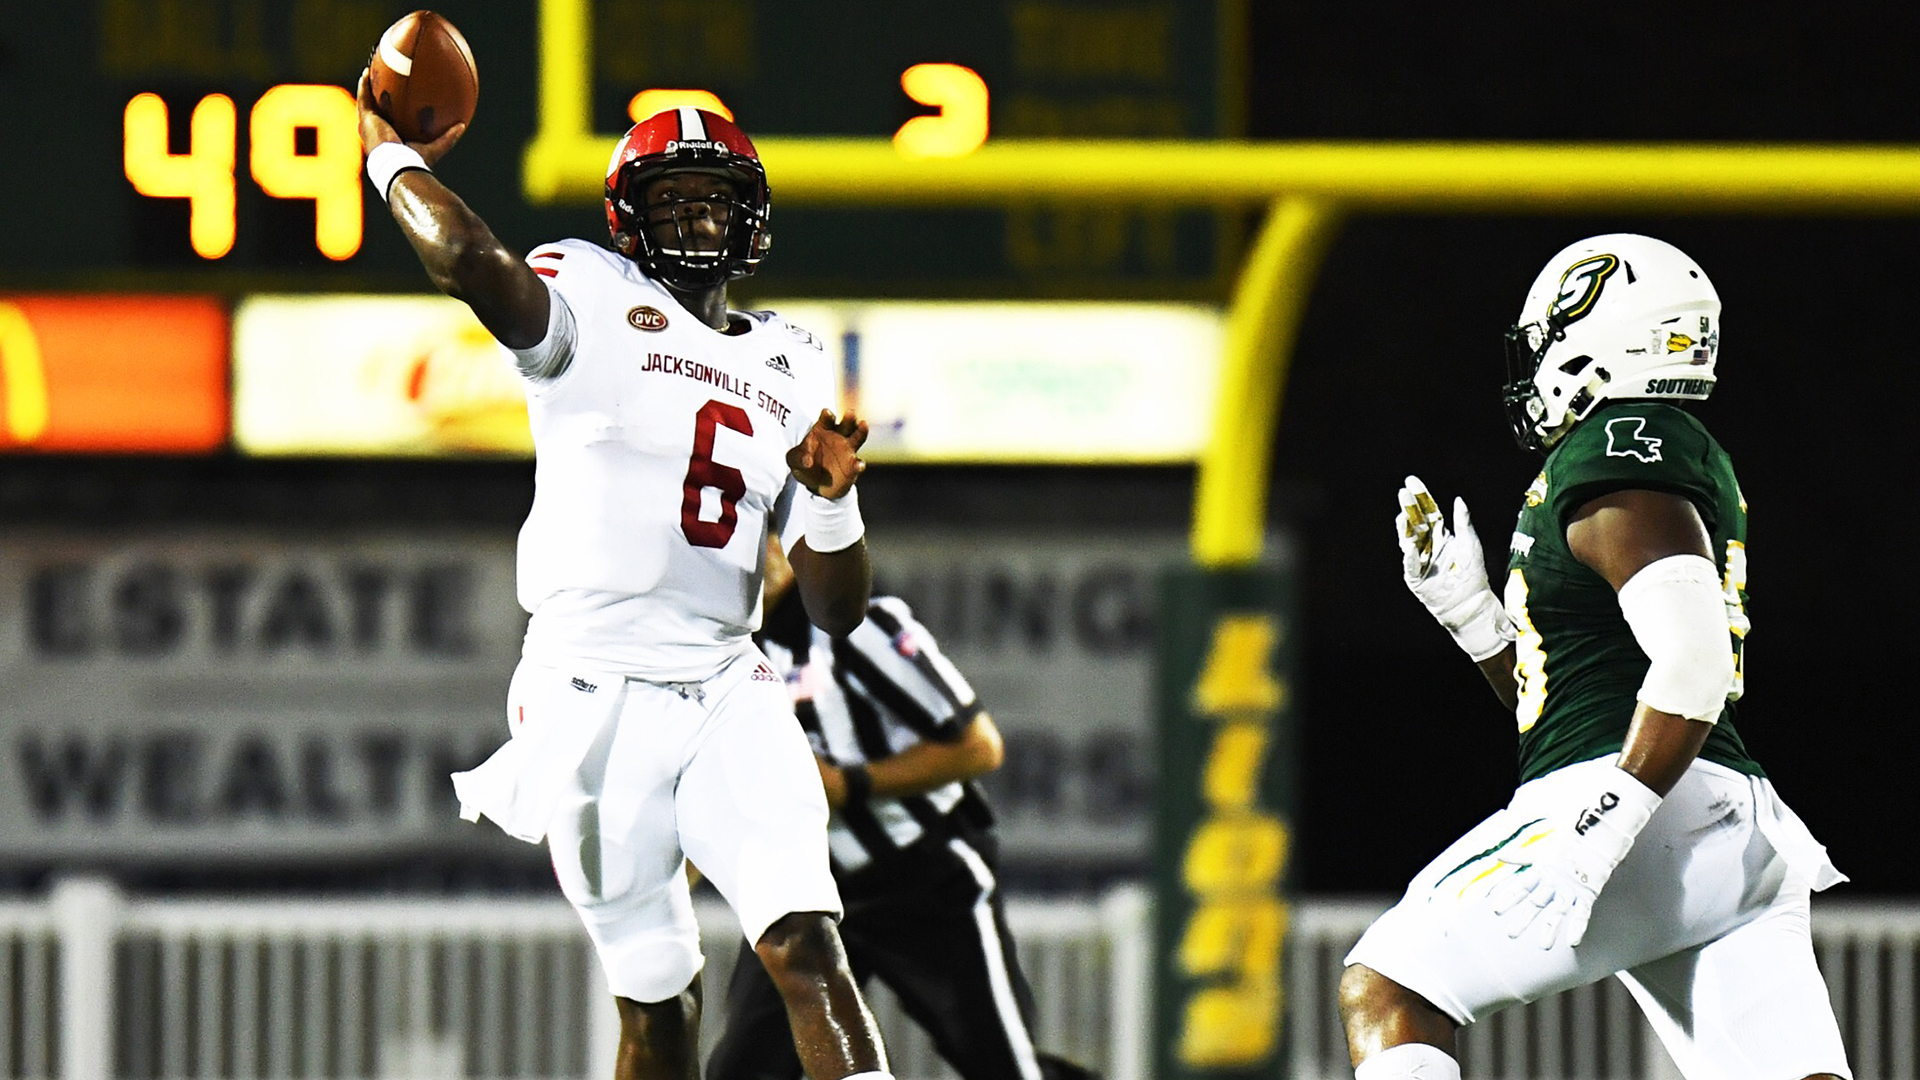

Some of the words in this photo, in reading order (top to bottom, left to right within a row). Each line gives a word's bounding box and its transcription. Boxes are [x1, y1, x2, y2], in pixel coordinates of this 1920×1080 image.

[124, 84, 363, 260] 49
[634, 312, 661, 327] OVC
[641, 352, 752, 401] JACKSONVILLE
[757, 389, 792, 428] STATE
[765, 360, 796, 380] adidas
[680, 398, 755, 550] 6
[26, 562, 480, 662] ESTATE
